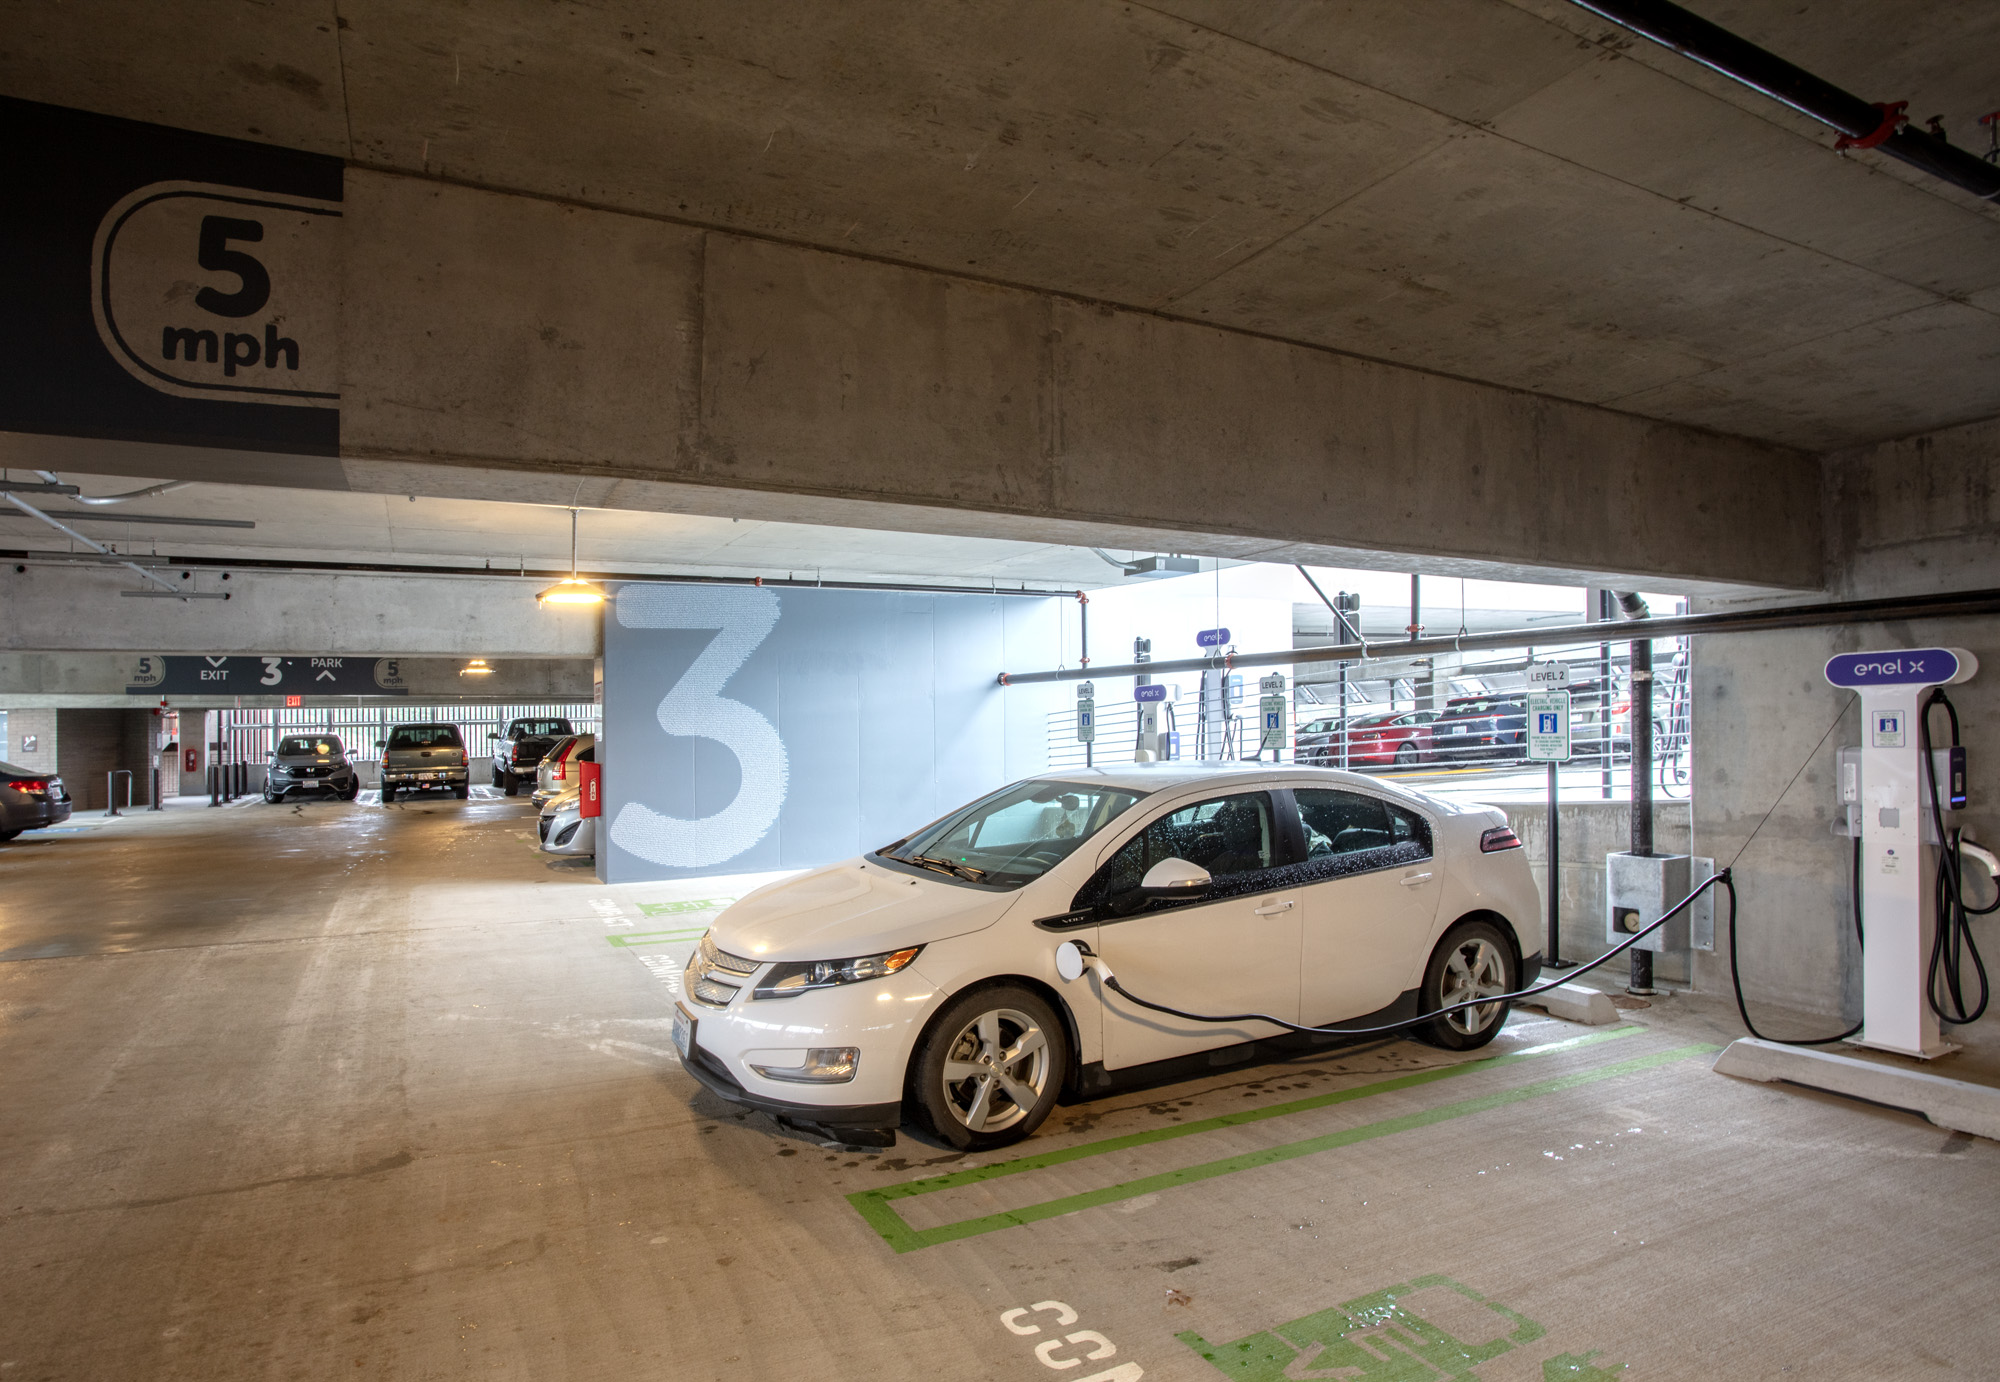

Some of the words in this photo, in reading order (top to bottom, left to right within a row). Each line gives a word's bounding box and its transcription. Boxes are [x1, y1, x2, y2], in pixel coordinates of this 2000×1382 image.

[195, 216, 271, 318] 5
[162, 325, 300, 377] mph
[139, 657, 152, 674] 5
[311, 658, 343, 668] PARK
[1853, 658, 1903, 676] enel
[260, 657, 283, 686] 3
[388, 661, 399, 677] 5
[134, 674, 157, 683] mph
[200, 670, 229, 680] EXIT
[1530, 672, 1557, 682] LEVEL
[1559, 671, 1565, 680] 2
[383, 677, 403, 685] mph
[1261, 681, 1278, 689] LEVEL
[1141, 689, 1154, 698] enel
[286, 696, 301, 707] EXIT
[609, 584, 790, 868] 3
